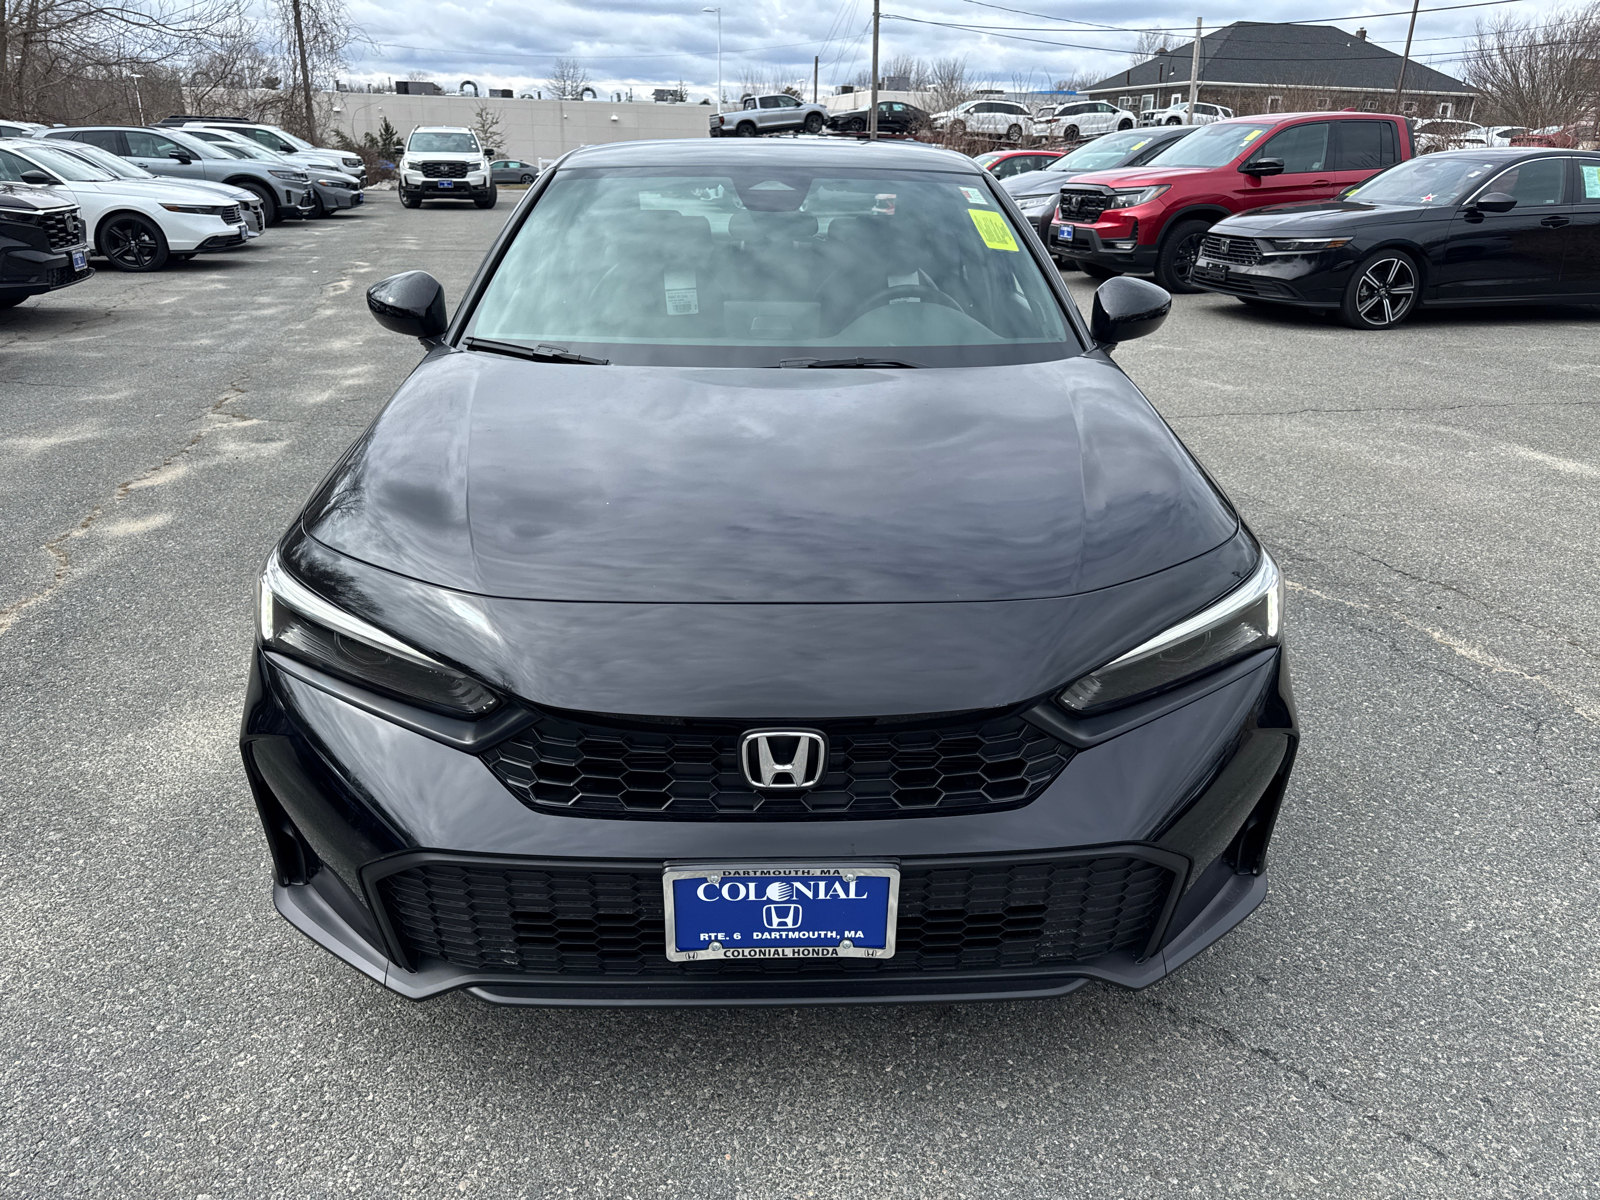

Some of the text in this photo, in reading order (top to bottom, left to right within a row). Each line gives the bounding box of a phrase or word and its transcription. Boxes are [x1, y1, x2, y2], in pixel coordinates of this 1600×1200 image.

[696, 881, 868, 902] COLONIAL
[699, 930, 865, 941] RTE. 6 DARTMOUTH, MA
[723, 948, 839, 958] COLONIAL HONDA
